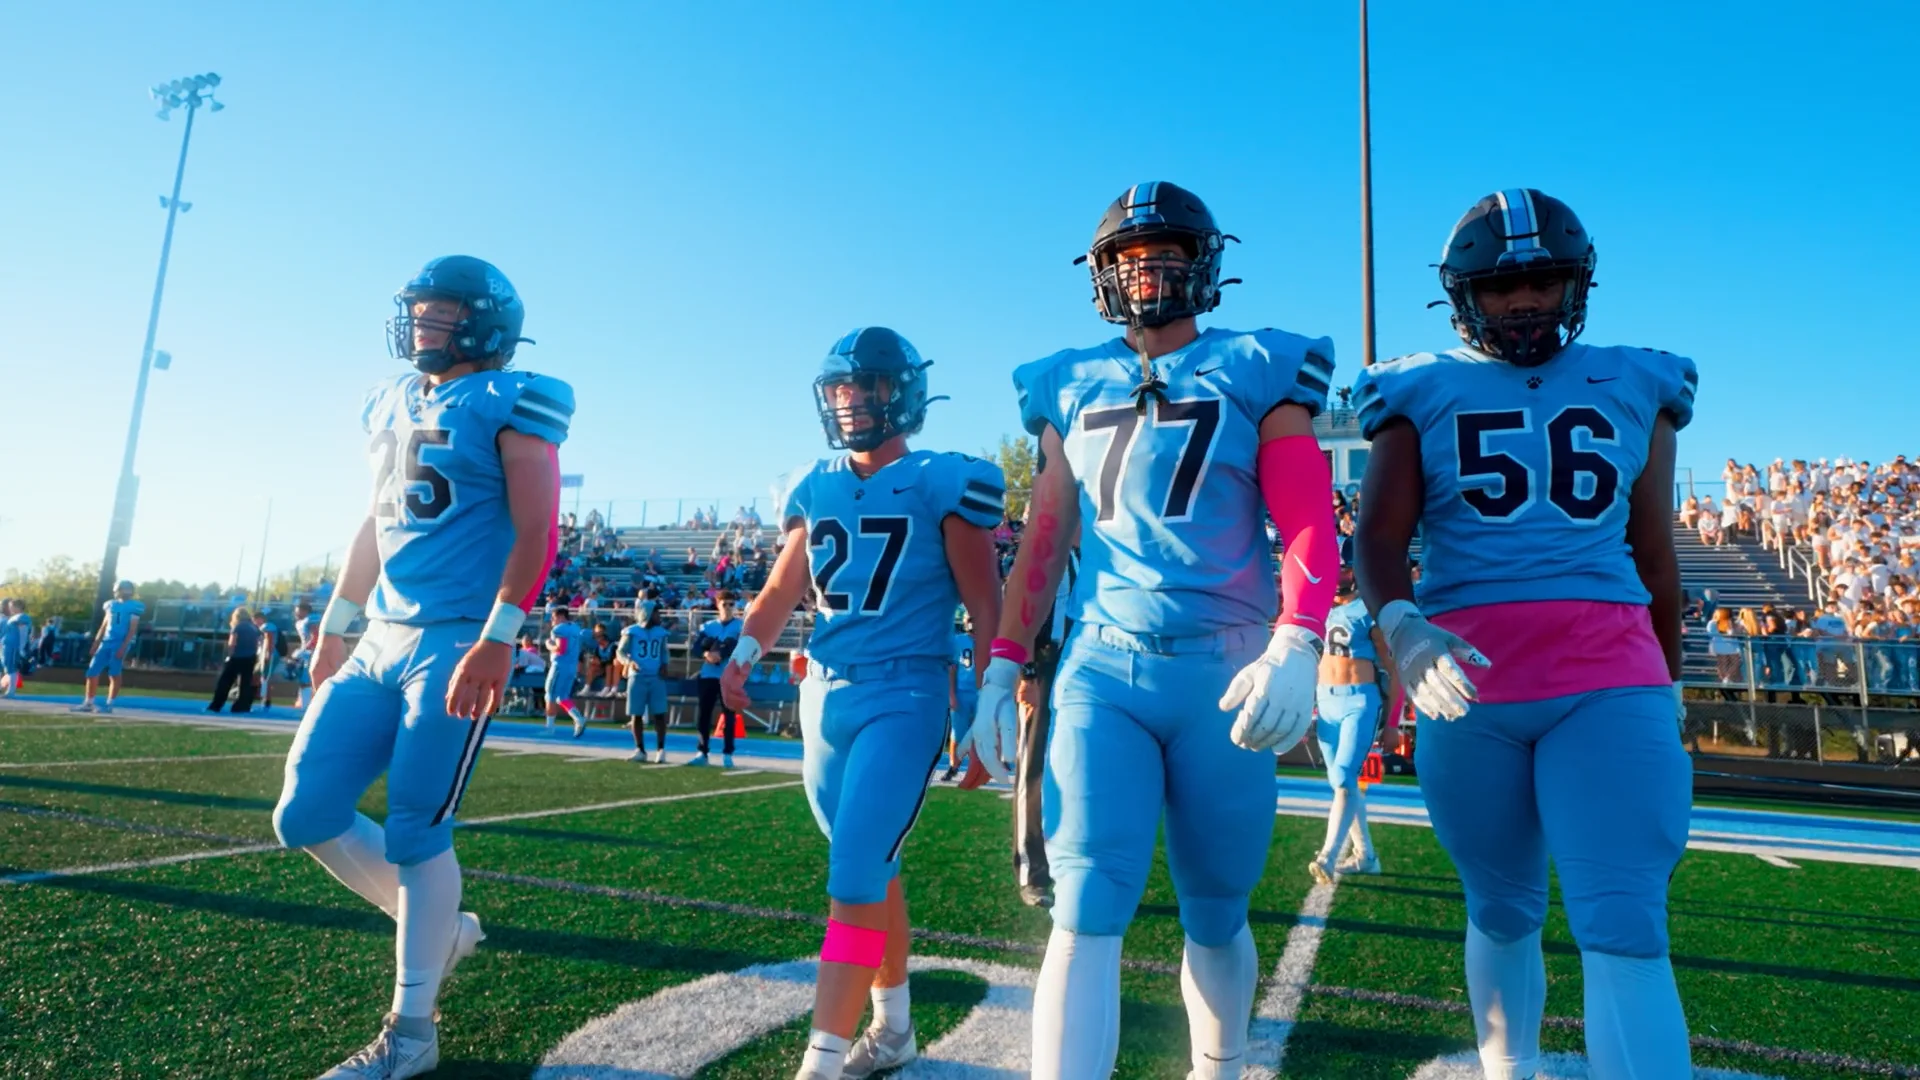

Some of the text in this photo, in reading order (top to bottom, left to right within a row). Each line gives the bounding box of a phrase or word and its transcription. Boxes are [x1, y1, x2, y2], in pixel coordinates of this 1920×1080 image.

[369, 428, 457, 524] 25
[1080, 396, 1227, 524] 77
[1455, 405, 1623, 525] 56
[810, 515, 913, 616] 27
[637, 638, 660, 659] 30
